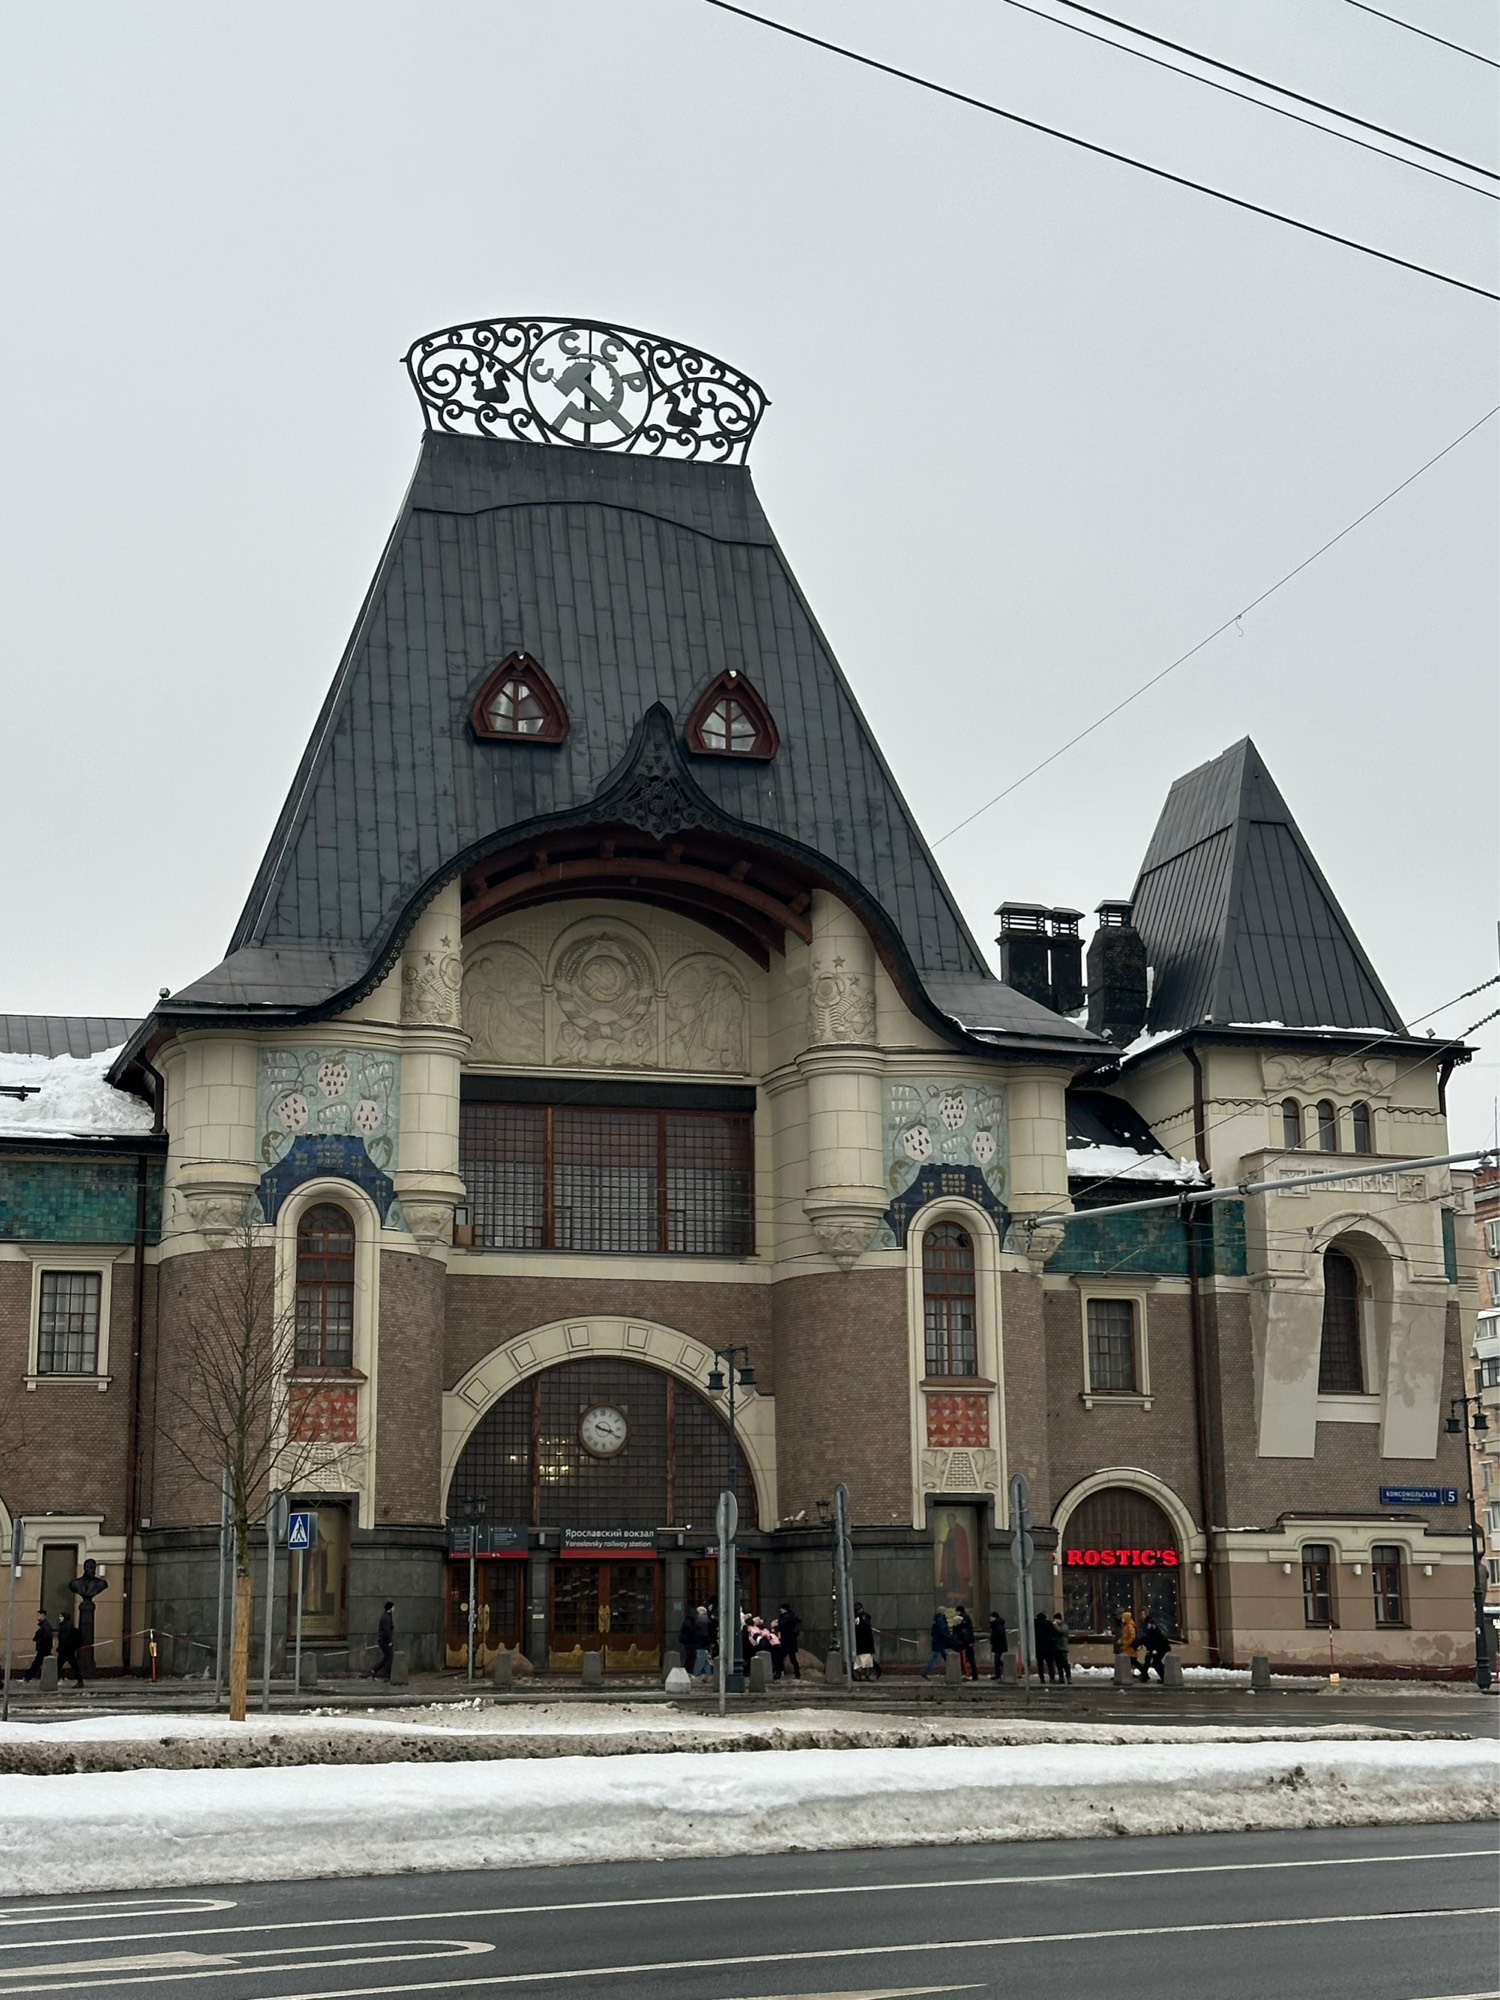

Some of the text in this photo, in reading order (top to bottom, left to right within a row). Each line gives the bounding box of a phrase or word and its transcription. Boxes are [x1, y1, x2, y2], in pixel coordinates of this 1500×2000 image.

[530, 331, 647, 392] СССР
[1447, 1491, 1455, 1502] 5
[565, 1528, 654, 1539] Ярославский вокзал
[565, 1540, 652, 1549] Yaroslavsky railway station
[1067, 1549, 1178, 1566] ROSTIC'S
